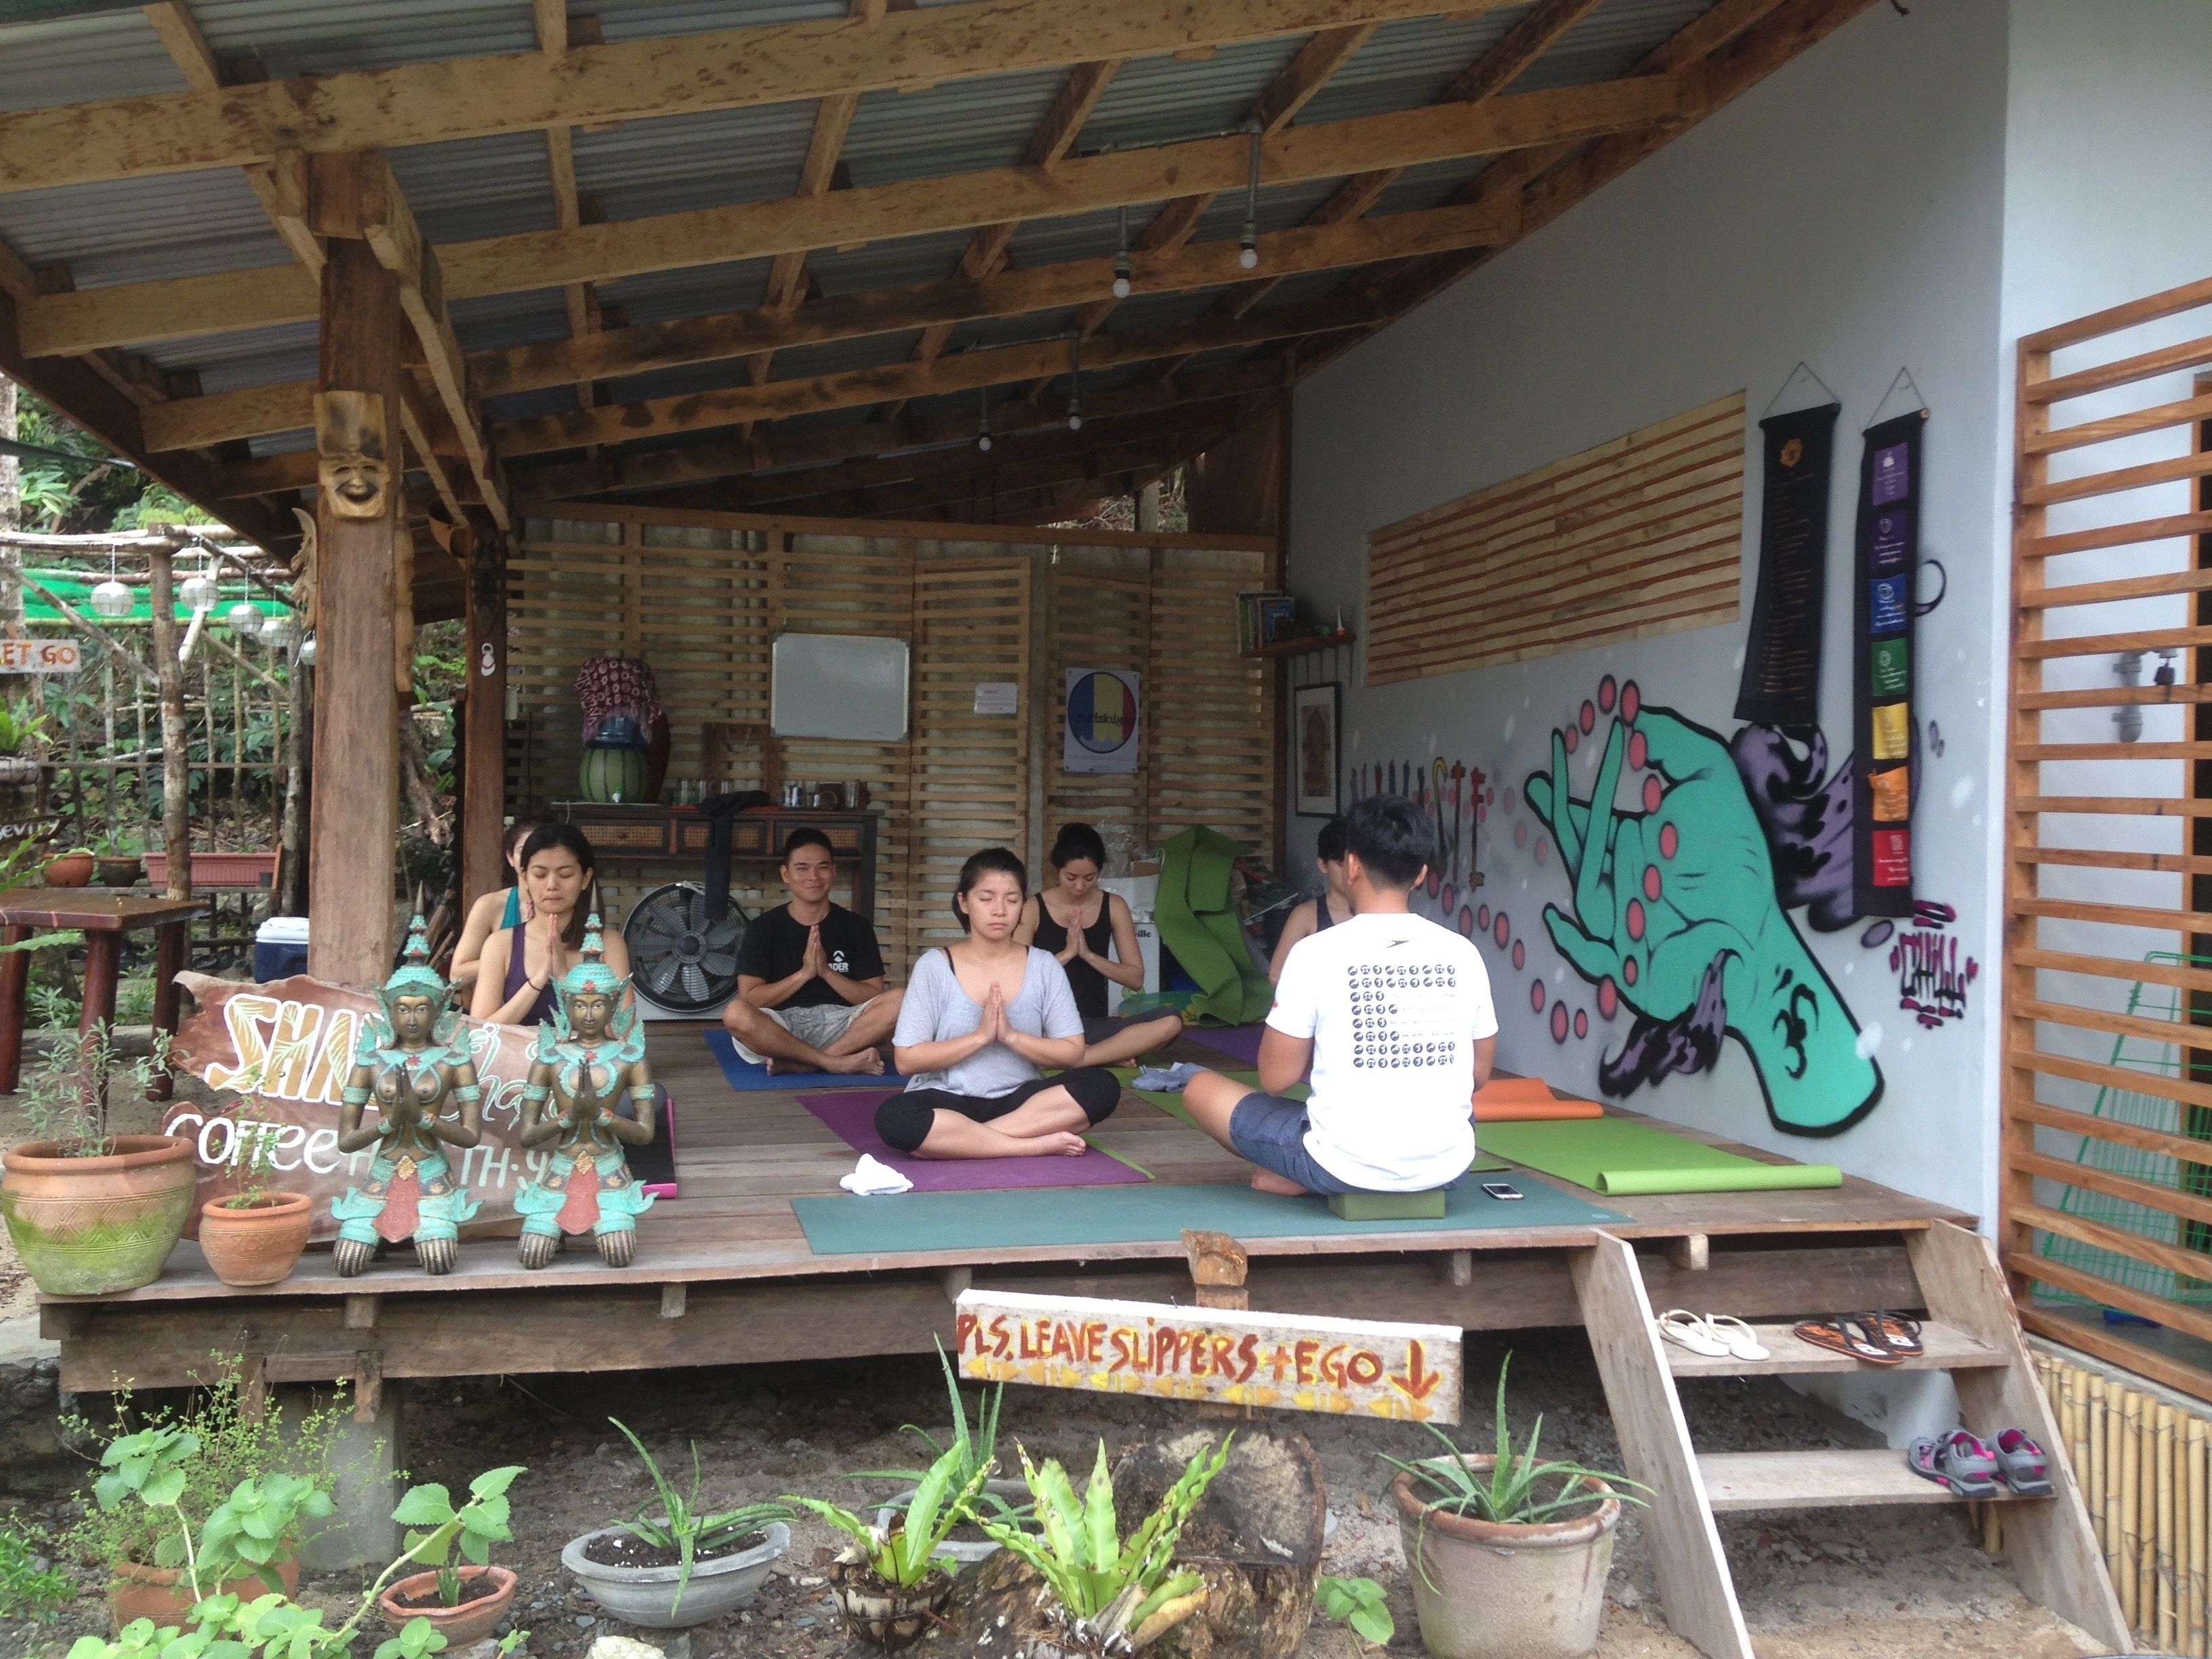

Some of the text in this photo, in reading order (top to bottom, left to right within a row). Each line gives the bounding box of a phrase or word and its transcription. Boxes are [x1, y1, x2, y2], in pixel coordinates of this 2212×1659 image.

[0, 642, 76, 665] ET GO
[957, 1314, 1014, 1361] PLS.
[1020, 1319, 1108, 1365] LEAVE
[1294, 1338, 1383, 1389] EGO
